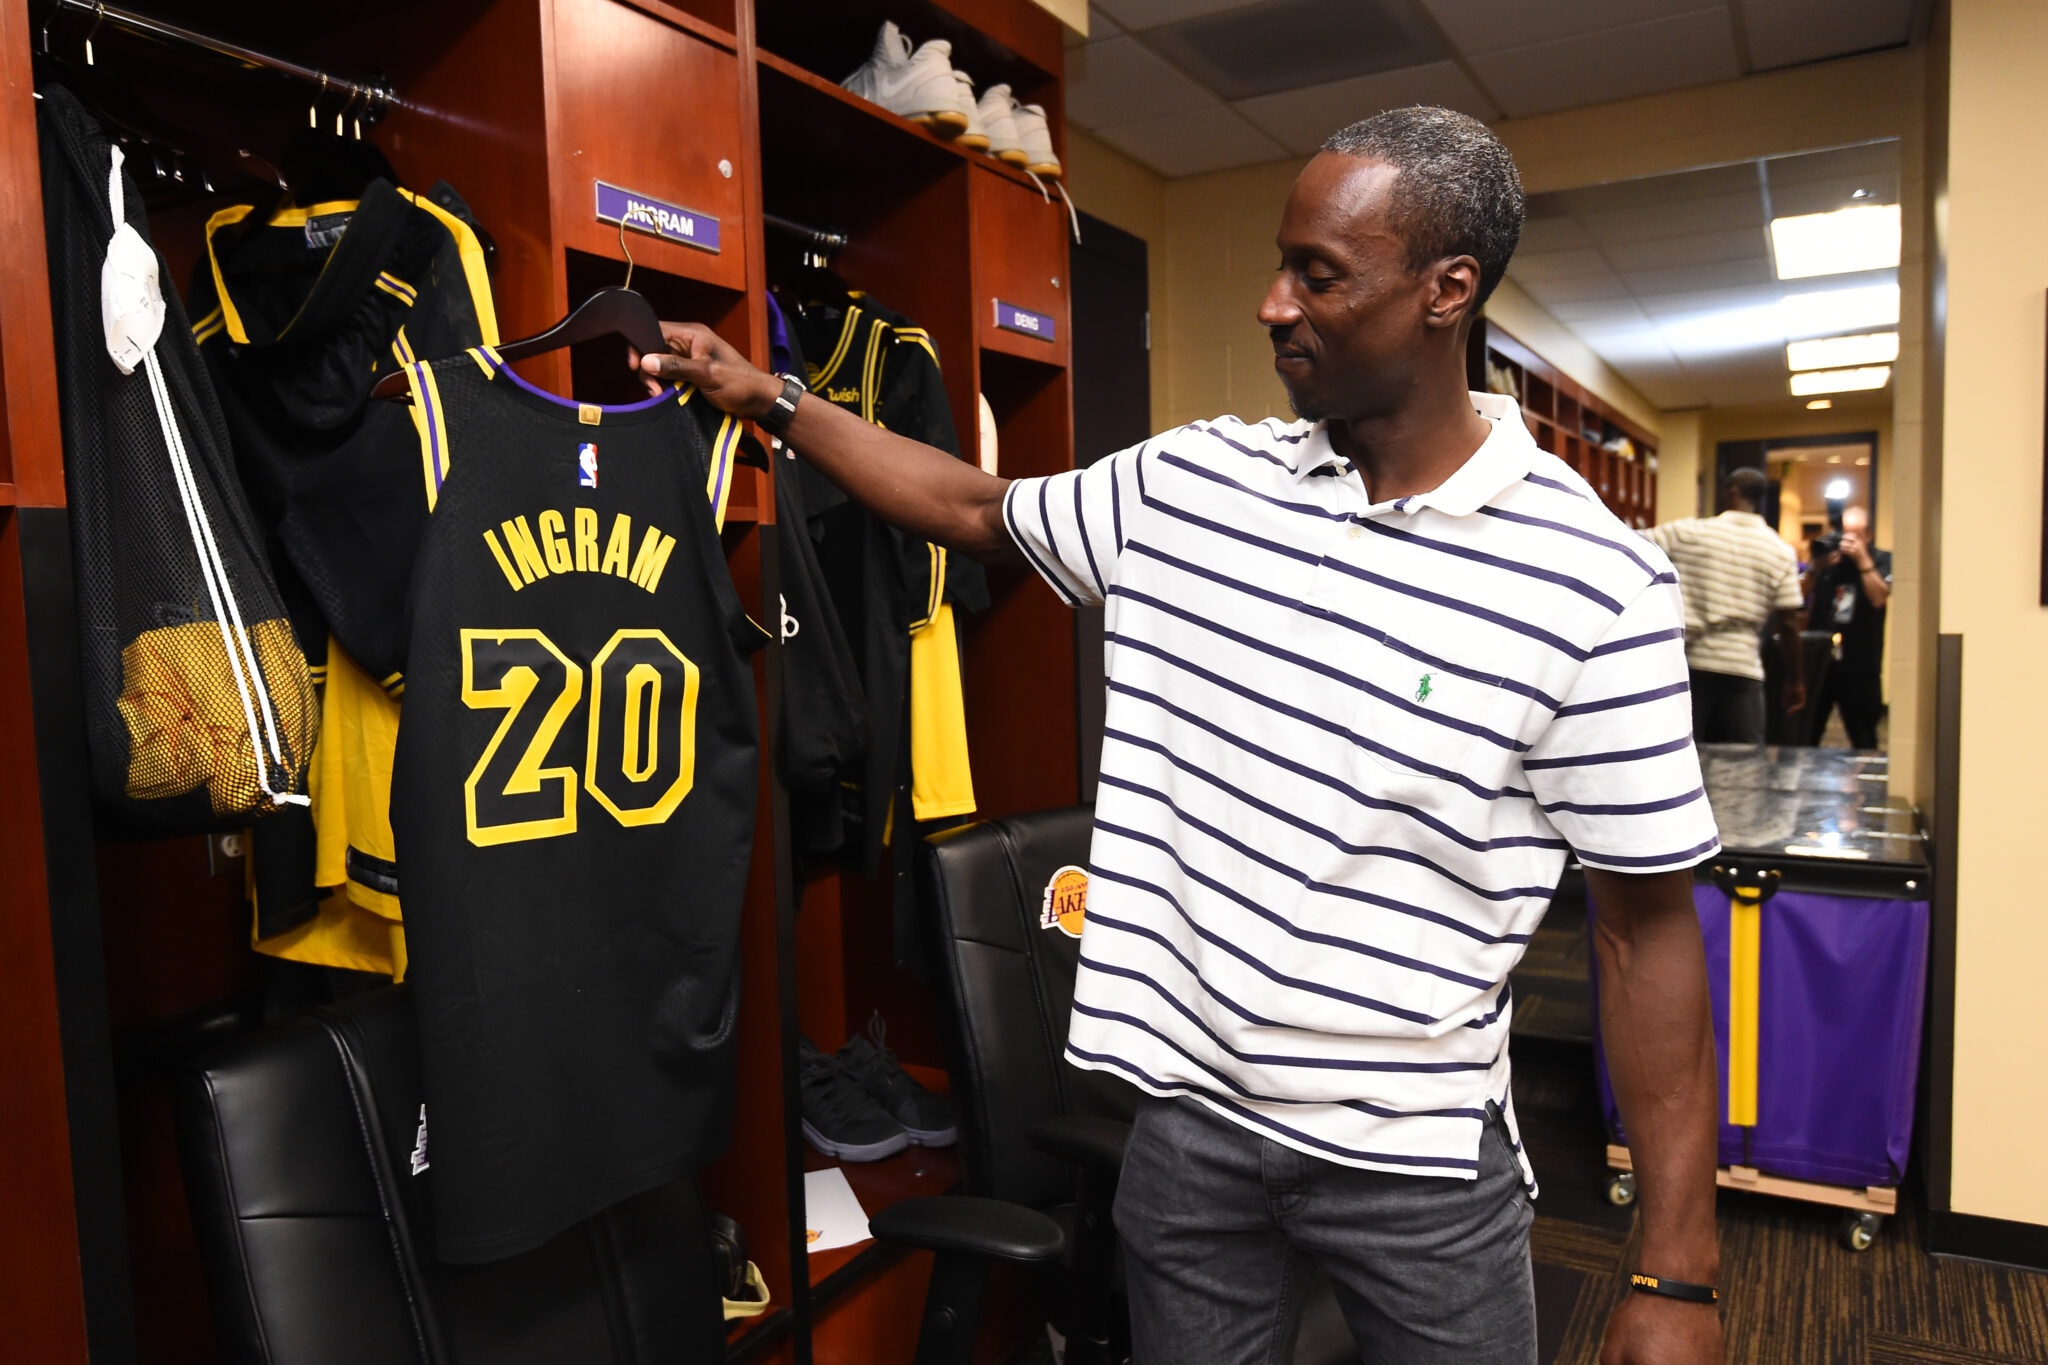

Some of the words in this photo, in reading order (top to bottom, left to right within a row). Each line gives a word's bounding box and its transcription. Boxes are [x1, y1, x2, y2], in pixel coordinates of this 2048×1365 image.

[626, 200, 694, 237] INGRAM
[1014, 312, 1040, 331] DENG
[826, 387, 861, 403] wish
[483, 507, 677, 594] INGRAM
[460, 628, 700, 848] 20
[1042, 889, 1087, 924] LAKE
